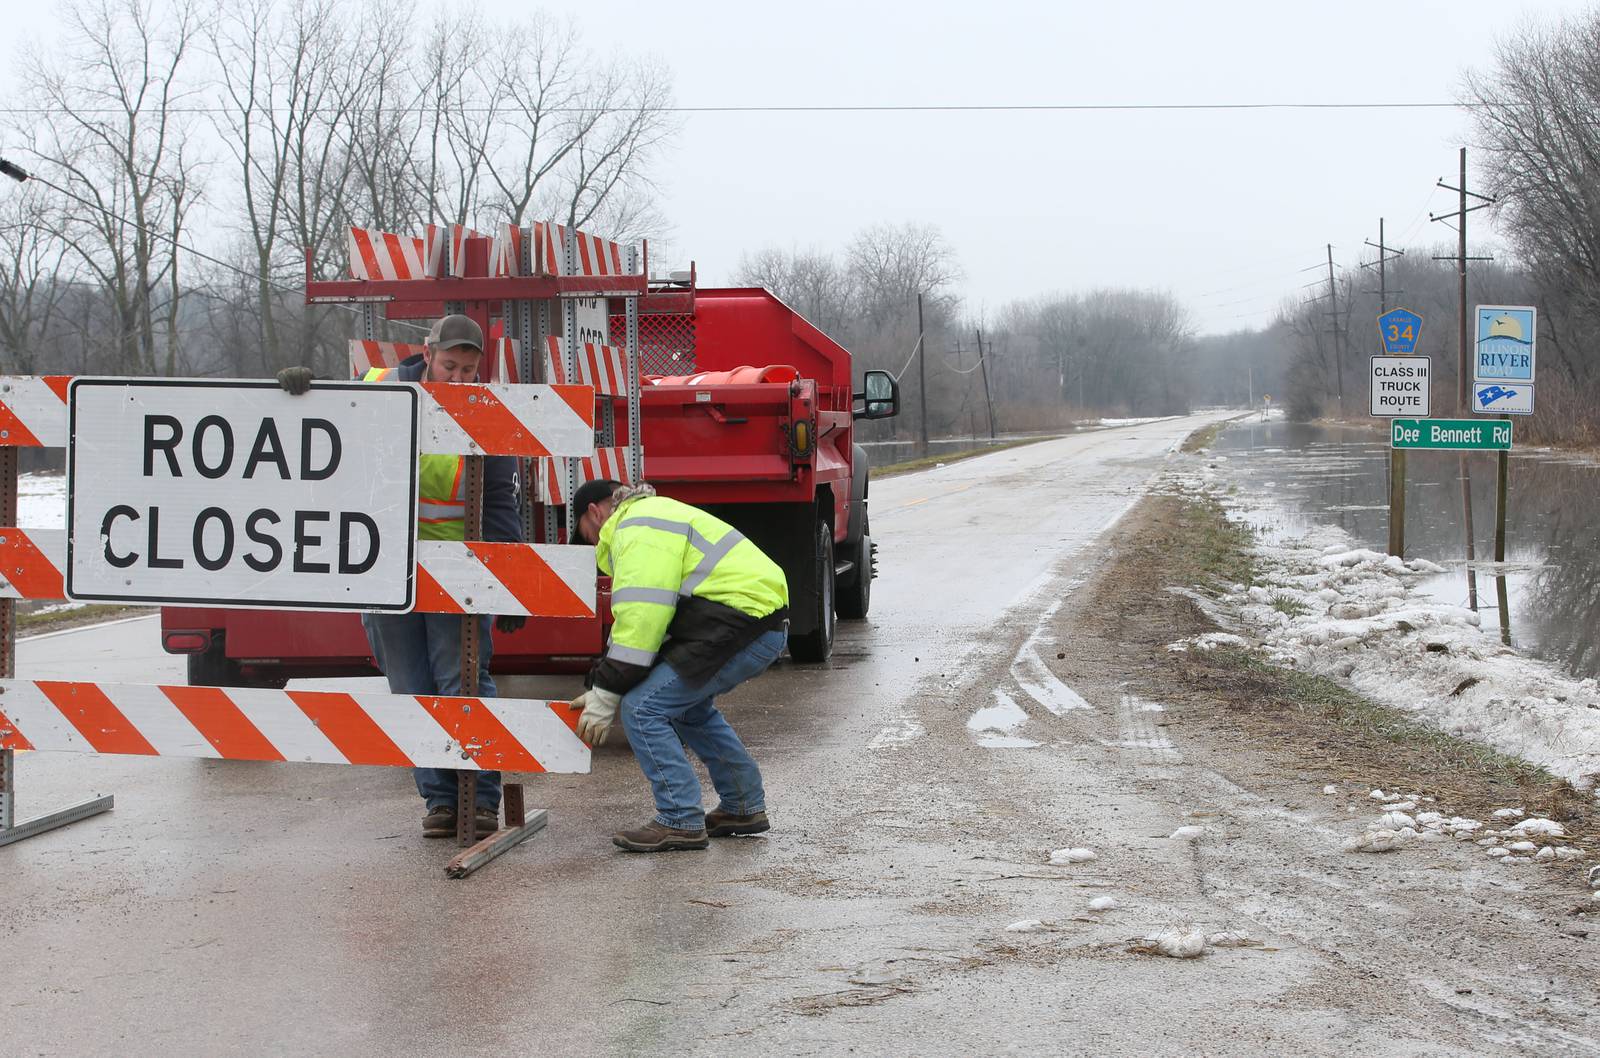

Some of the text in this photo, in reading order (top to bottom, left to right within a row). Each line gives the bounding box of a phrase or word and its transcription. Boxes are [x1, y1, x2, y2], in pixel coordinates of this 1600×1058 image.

[1388, 325, 1414, 341] 34
[1480, 343, 1530, 354] ILLINOIS
[1480, 353, 1529, 368] RIVER
[1374, 367, 1427, 378] CLASS III
[1480, 366, 1513, 376] ROAD
[1380, 381, 1421, 391] TRUCK
[1380, 396, 1421, 406] ROUTE
[1394, 425, 1510, 443] Dee Bennett Rd
[143, 414, 342, 481] ROAD
[100, 504, 381, 575] CLOSED
